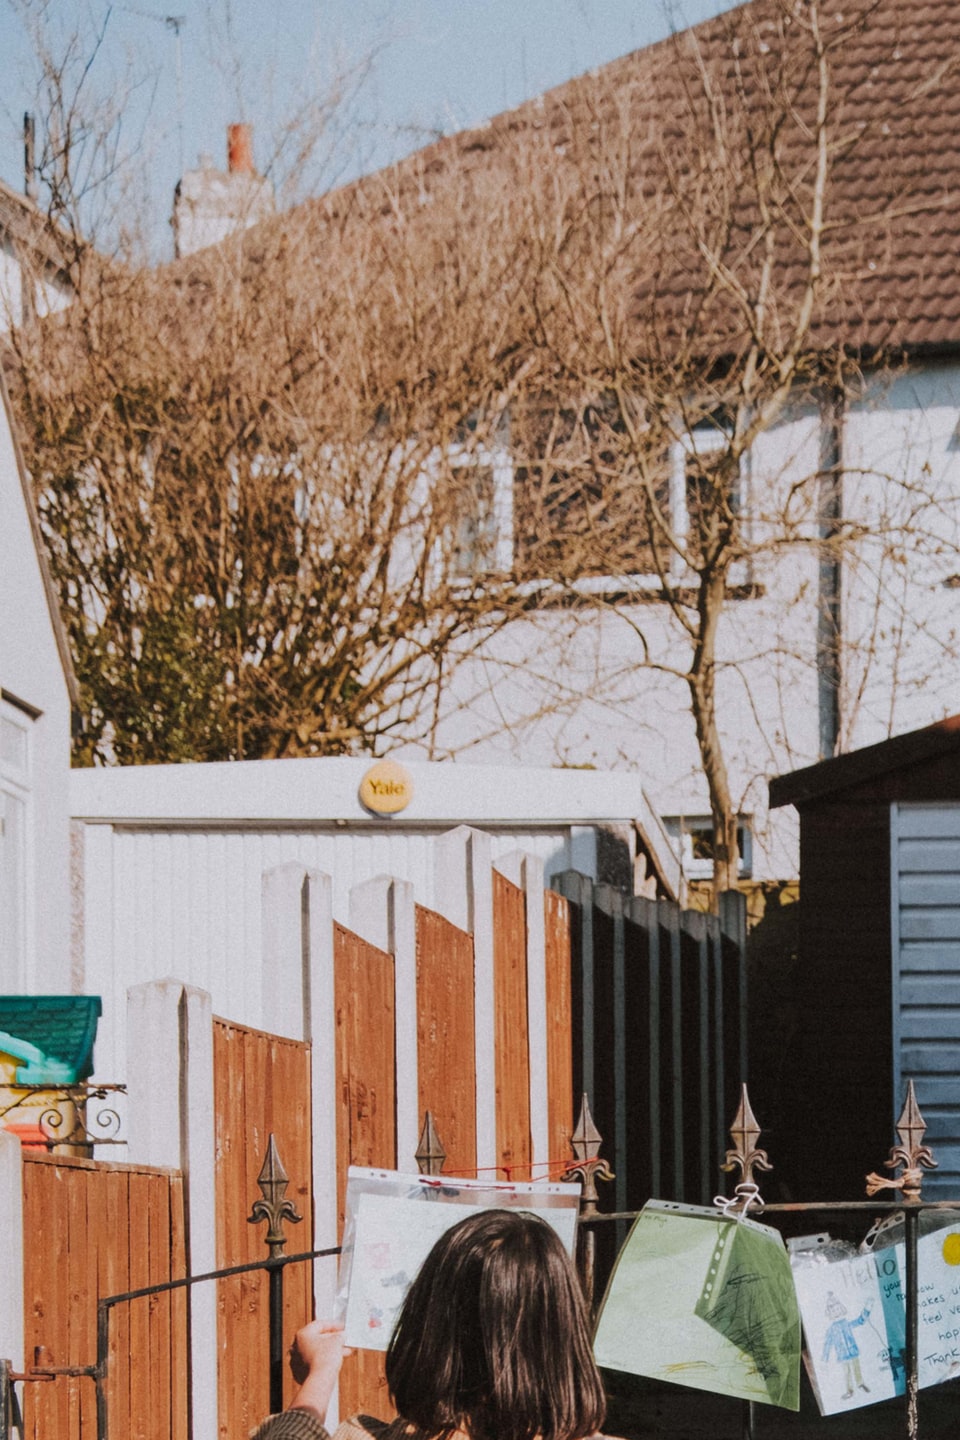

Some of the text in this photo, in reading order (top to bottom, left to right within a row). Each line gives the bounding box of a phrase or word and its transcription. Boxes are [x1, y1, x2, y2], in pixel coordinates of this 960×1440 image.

[368, 779, 405, 796] Yale
[841, 1257, 897, 1289] Hello
[922, 1311, 943, 1325] feel
